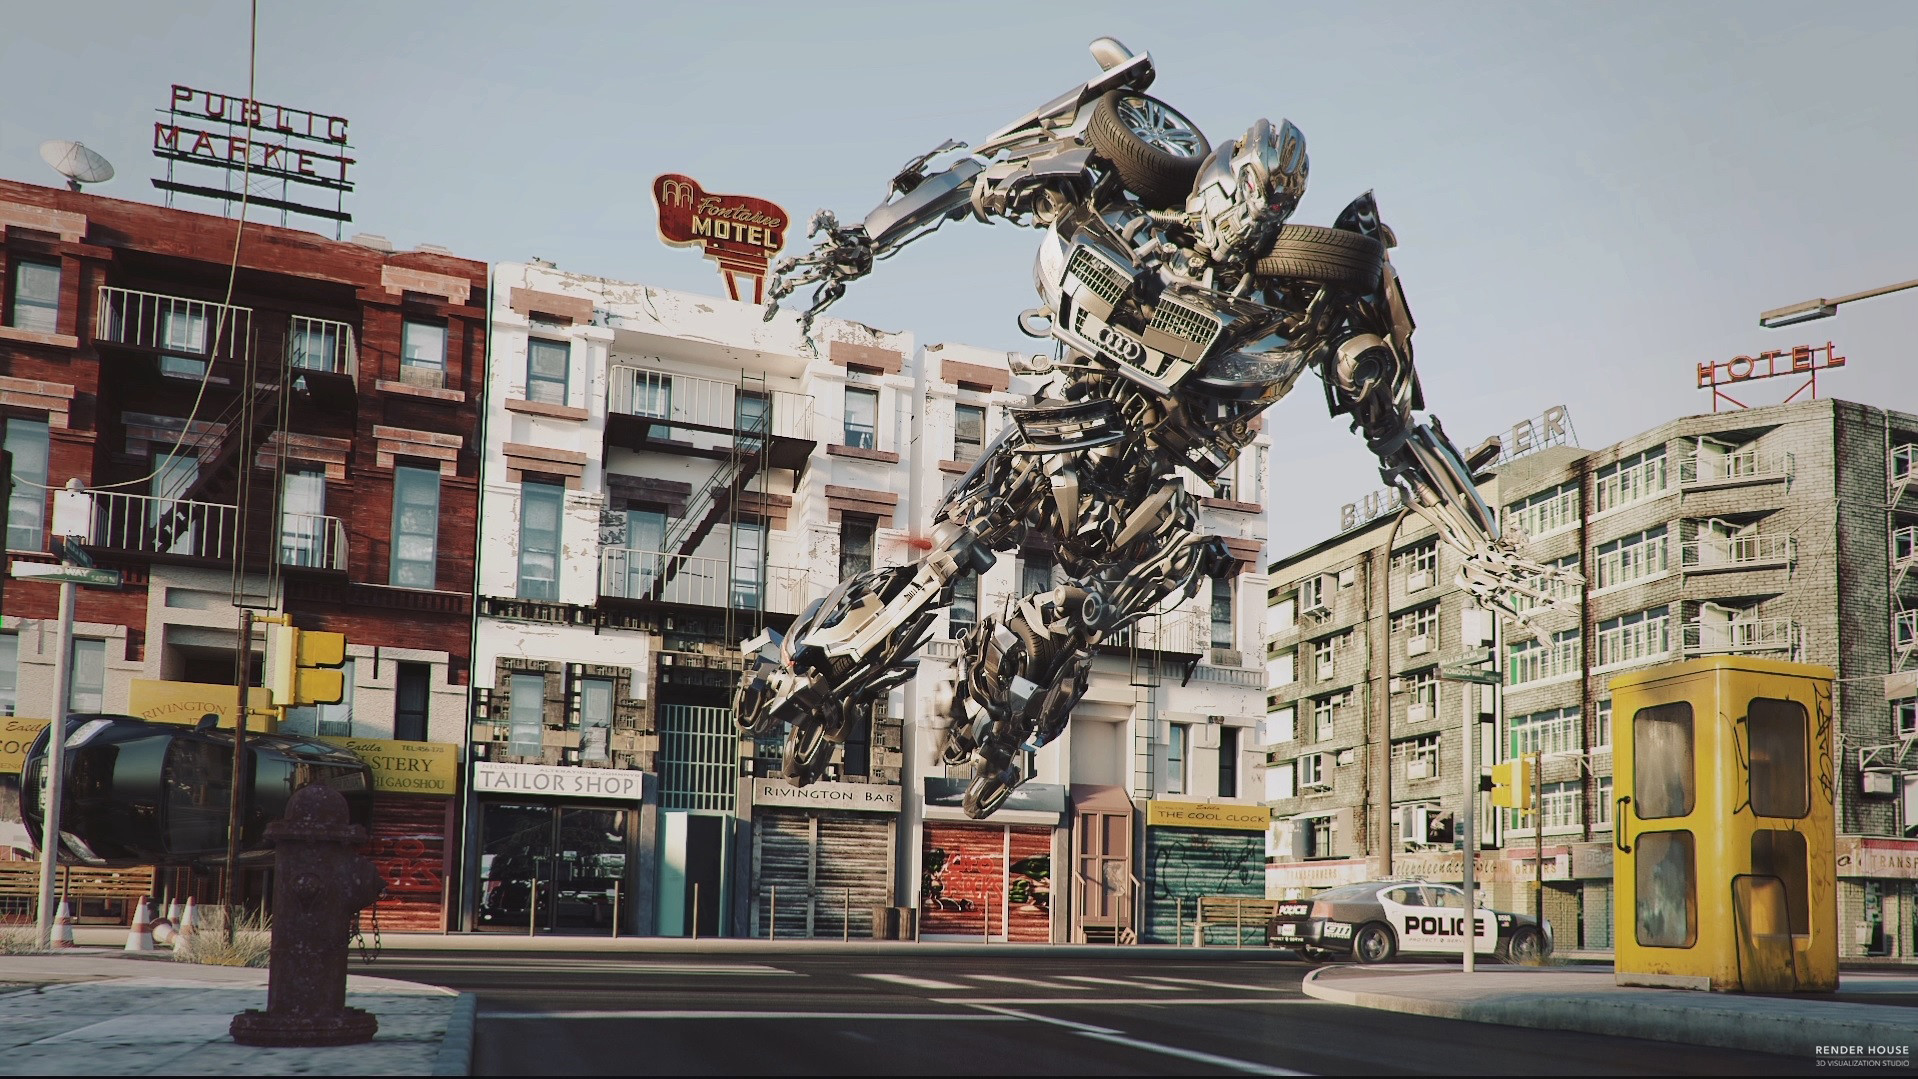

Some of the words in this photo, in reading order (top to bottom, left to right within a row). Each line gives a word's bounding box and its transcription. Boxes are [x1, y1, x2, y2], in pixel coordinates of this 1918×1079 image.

[171, 84, 349, 143] PUBLIC
[154, 121, 356, 181] MARKET
[691, 214, 778, 249] MOTEL
[1697, 341, 1846, 389] HOTEL
[65, 567, 90, 578] WAY
[142, 701, 228, 721] RIVINGTON
[539, 768, 598, 776] ALTERATIONS
[385, 777, 412, 788] GAO
[414, 778, 446, 790] SHOU
[480, 770, 565, 791] TAILOR
[575, 775, 634, 794] SHOP
[764, 786, 853, 800] RIVINGTON
[865, 792, 894, 802] BAR
[1158, 810, 1184, 819] THE
[1187, 812, 1222, 821] COOL
[1226, 814, 1265, 823] CLOCK
[1280, 904, 1308, 915] POLICE
[1327, 925, 1350, 934] 911
